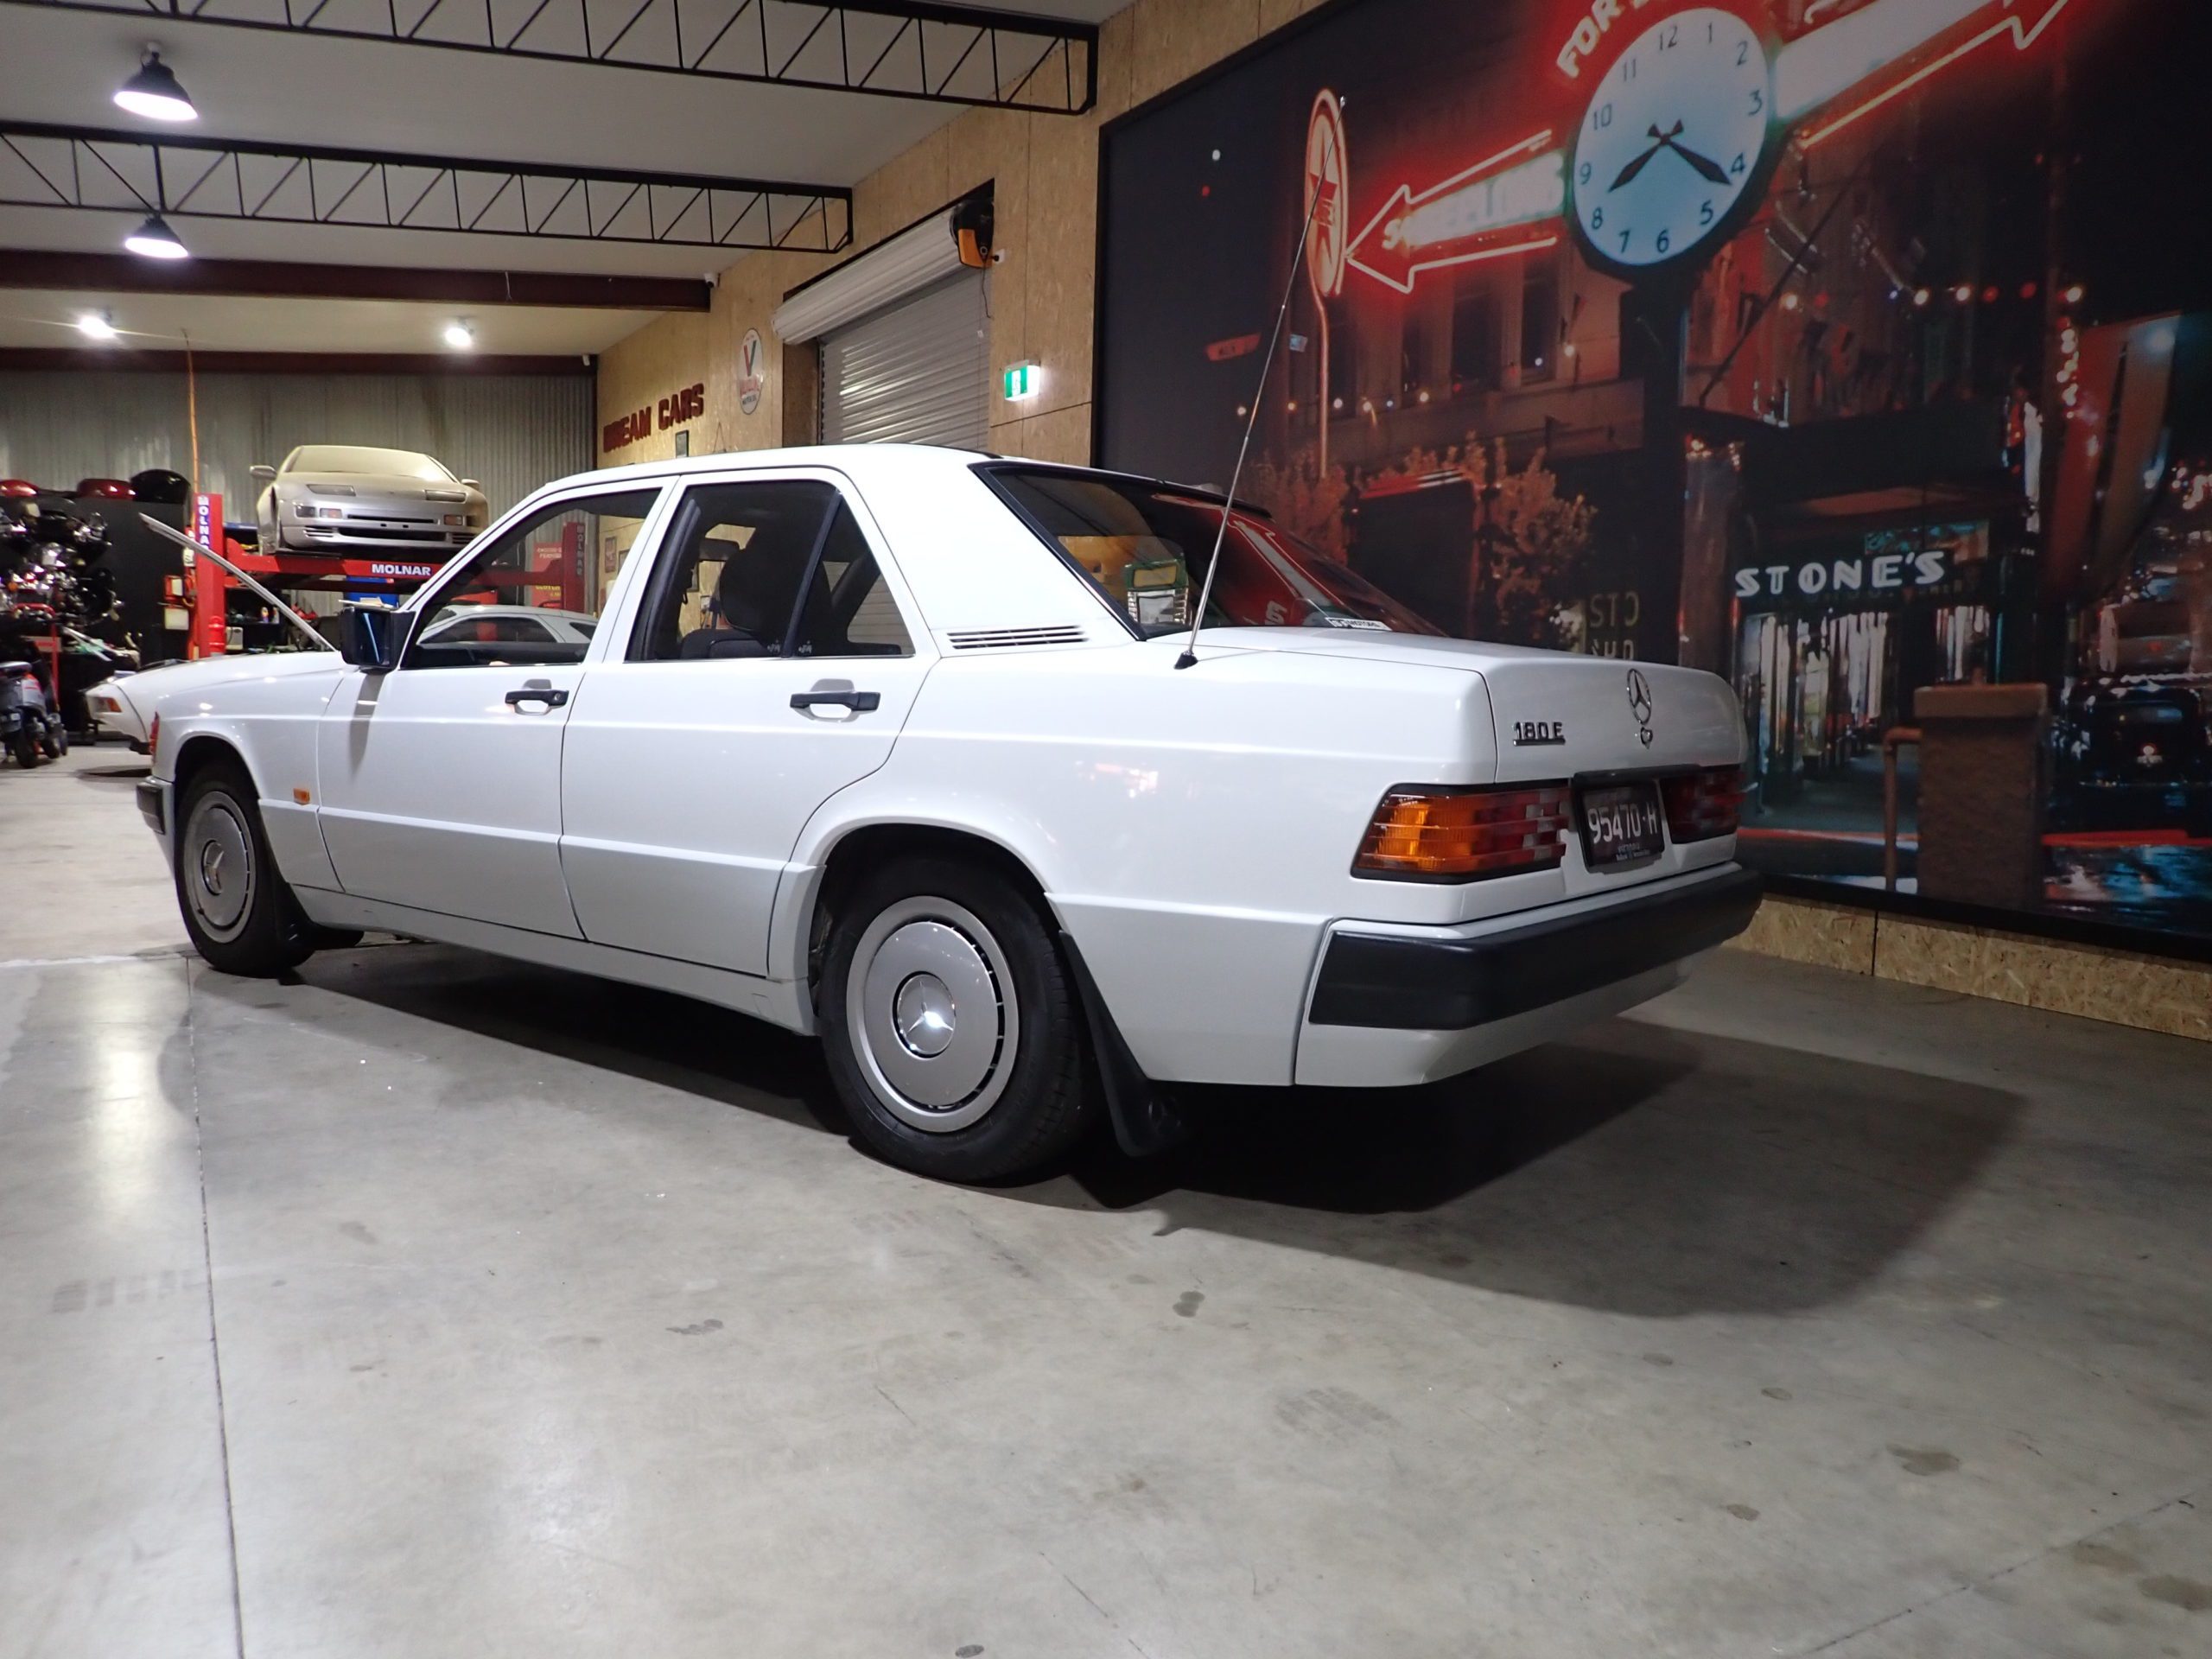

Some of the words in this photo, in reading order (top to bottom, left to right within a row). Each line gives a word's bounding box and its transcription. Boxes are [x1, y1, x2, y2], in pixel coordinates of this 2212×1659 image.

[1659, 25, 1679, 52] 12
[1707, 22, 1713, 44] 1
[1735, 40, 1749, 67] 2
[1622, 57, 1637, 82] 11
[1747, 89, 1764, 117] 3
[1592, 103, 1612, 130] 10
[1580, 162, 1592, 185] 9
[1731, 151, 1746, 174] 4
[1591, 207, 1604, 231] 8
[1700, 200, 1714, 226] 5
[1618, 229, 1631, 254] 7
[1656, 229, 1669, 253] 6
[658, 383, 704, 431] CARS
[372, 563, 432, 576] MOLNAR
[1734, 551, 1945, 597] STONE'S
